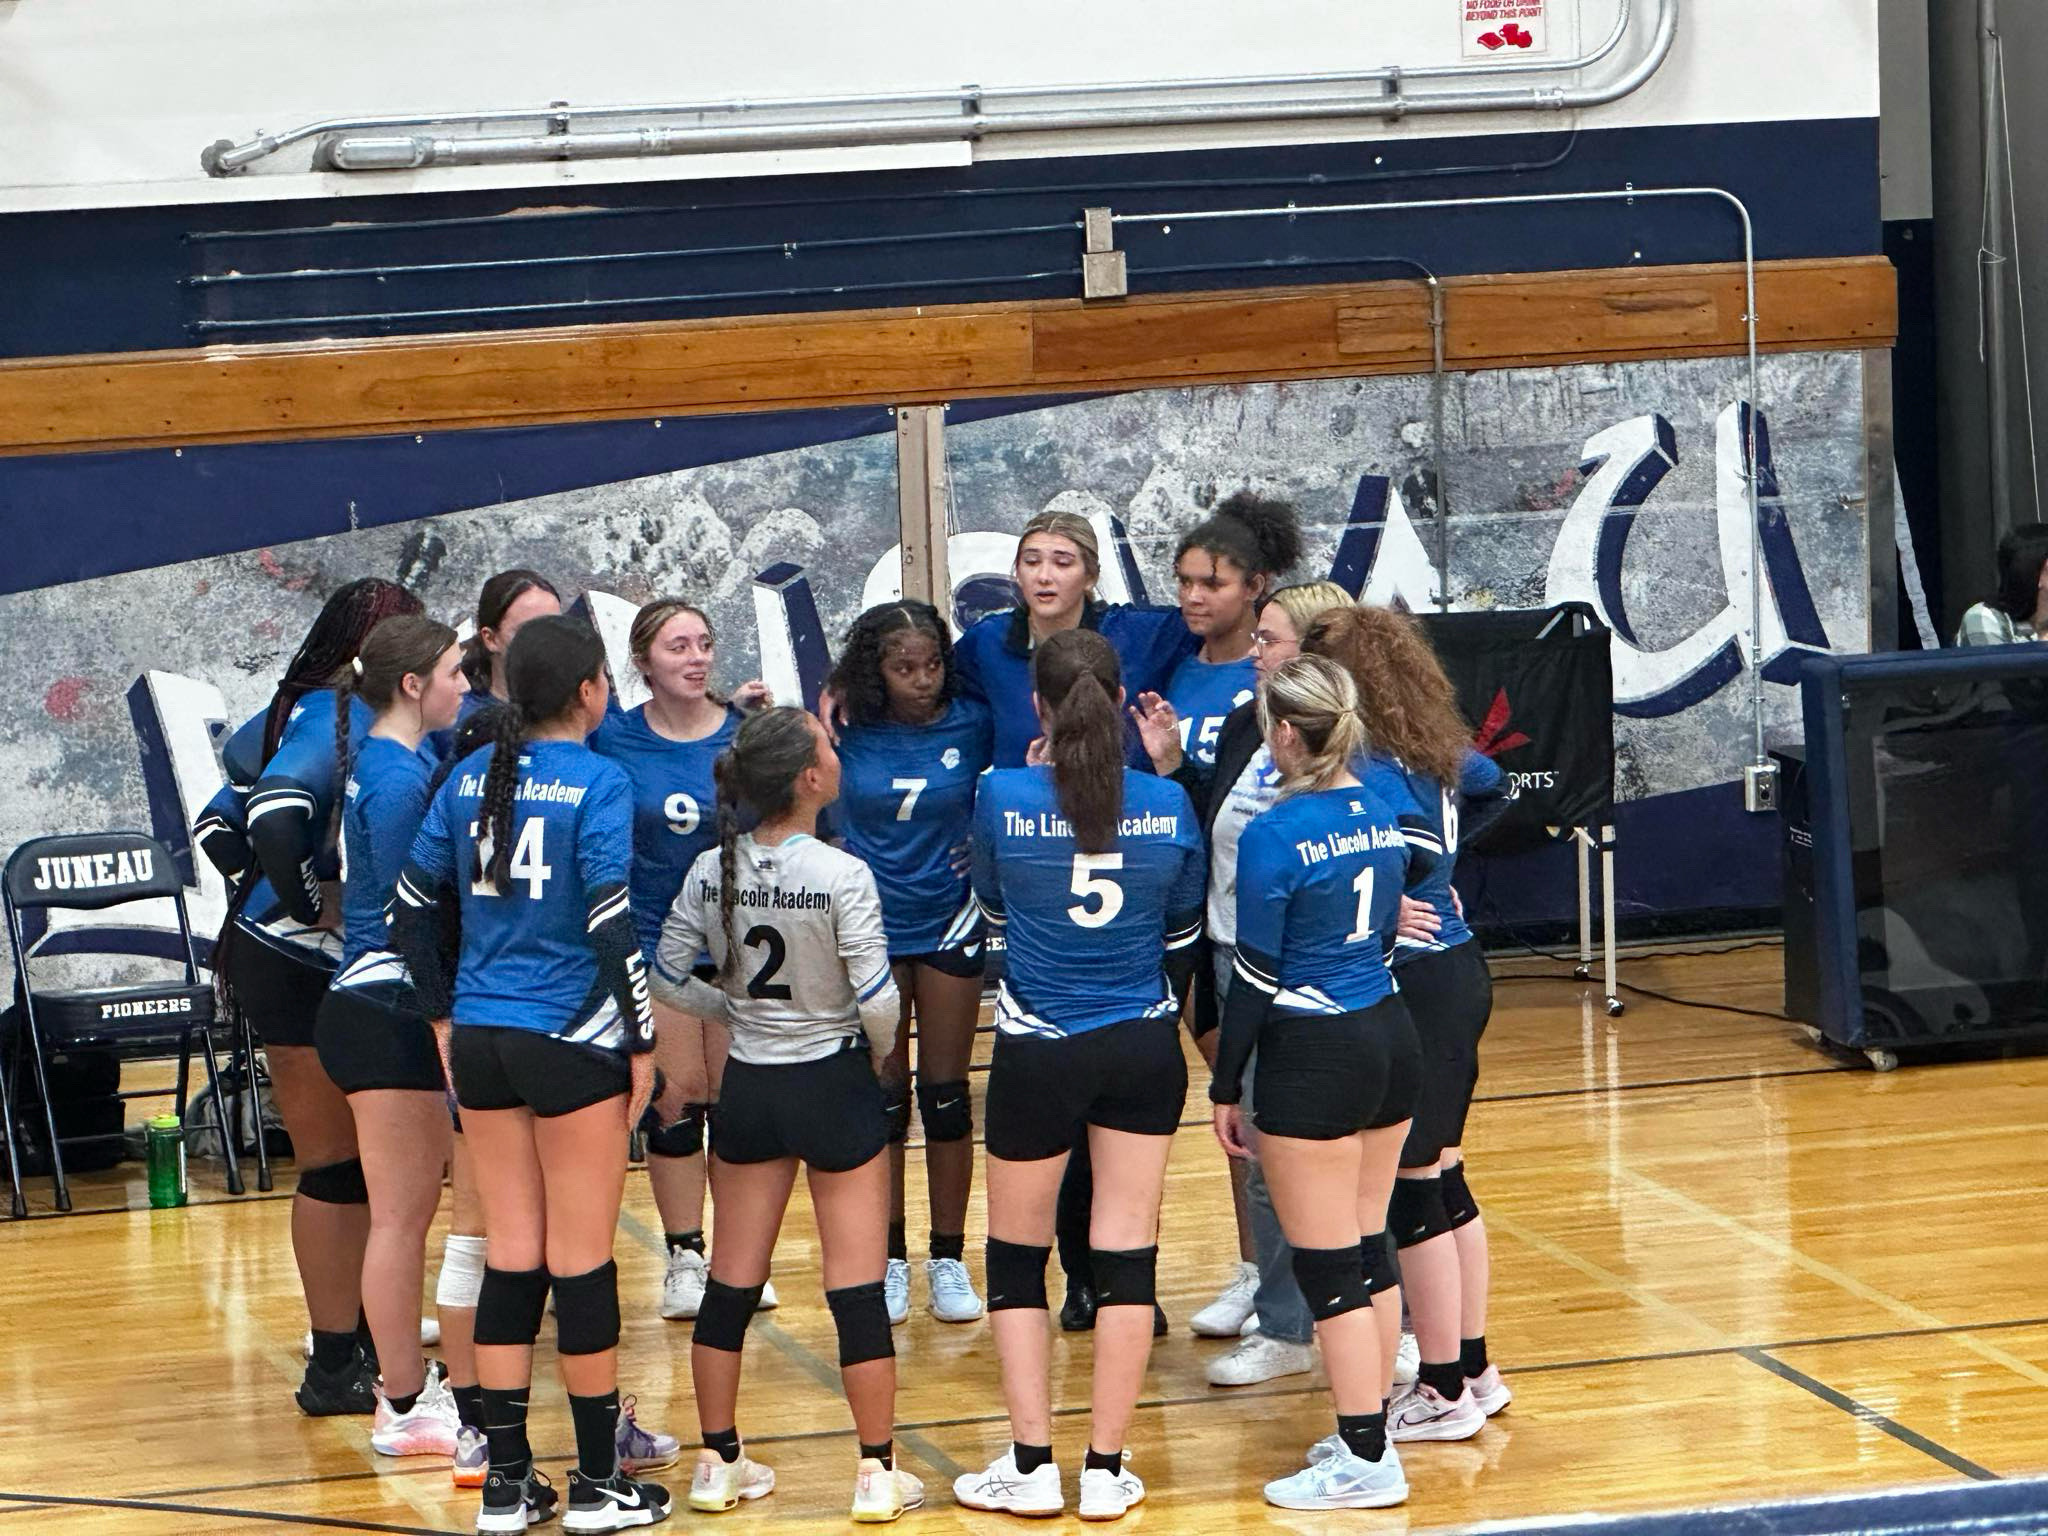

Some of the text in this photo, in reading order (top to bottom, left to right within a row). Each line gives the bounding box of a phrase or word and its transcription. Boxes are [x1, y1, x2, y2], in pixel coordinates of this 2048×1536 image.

[1500, 9, 1516, 18] THIS
[1519, 7, 1542, 17] POINT
[458, 774, 478, 797] The
[521, 777, 588, 808] Academy
[891, 778, 928, 821] 7
[664, 793, 700, 835] 9
[1003, 811, 1036, 837] The
[1115, 810, 1178, 839] cademy
[1296, 840, 1329, 866] The
[1327, 828, 1370, 857] Lincoln
[33, 848, 155, 890] JUNEAU
[700, 879, 719, 903] The
[772, 885, 832, 914] Academy
[1067, 852, 1124, 929] 5
[1343, 866, 1375, 944] 1
[743, 924, 793, 1001] 2
[101, 998, 192, 1020] PIONEERS
[625, 949, 655, 1041] LIONS
